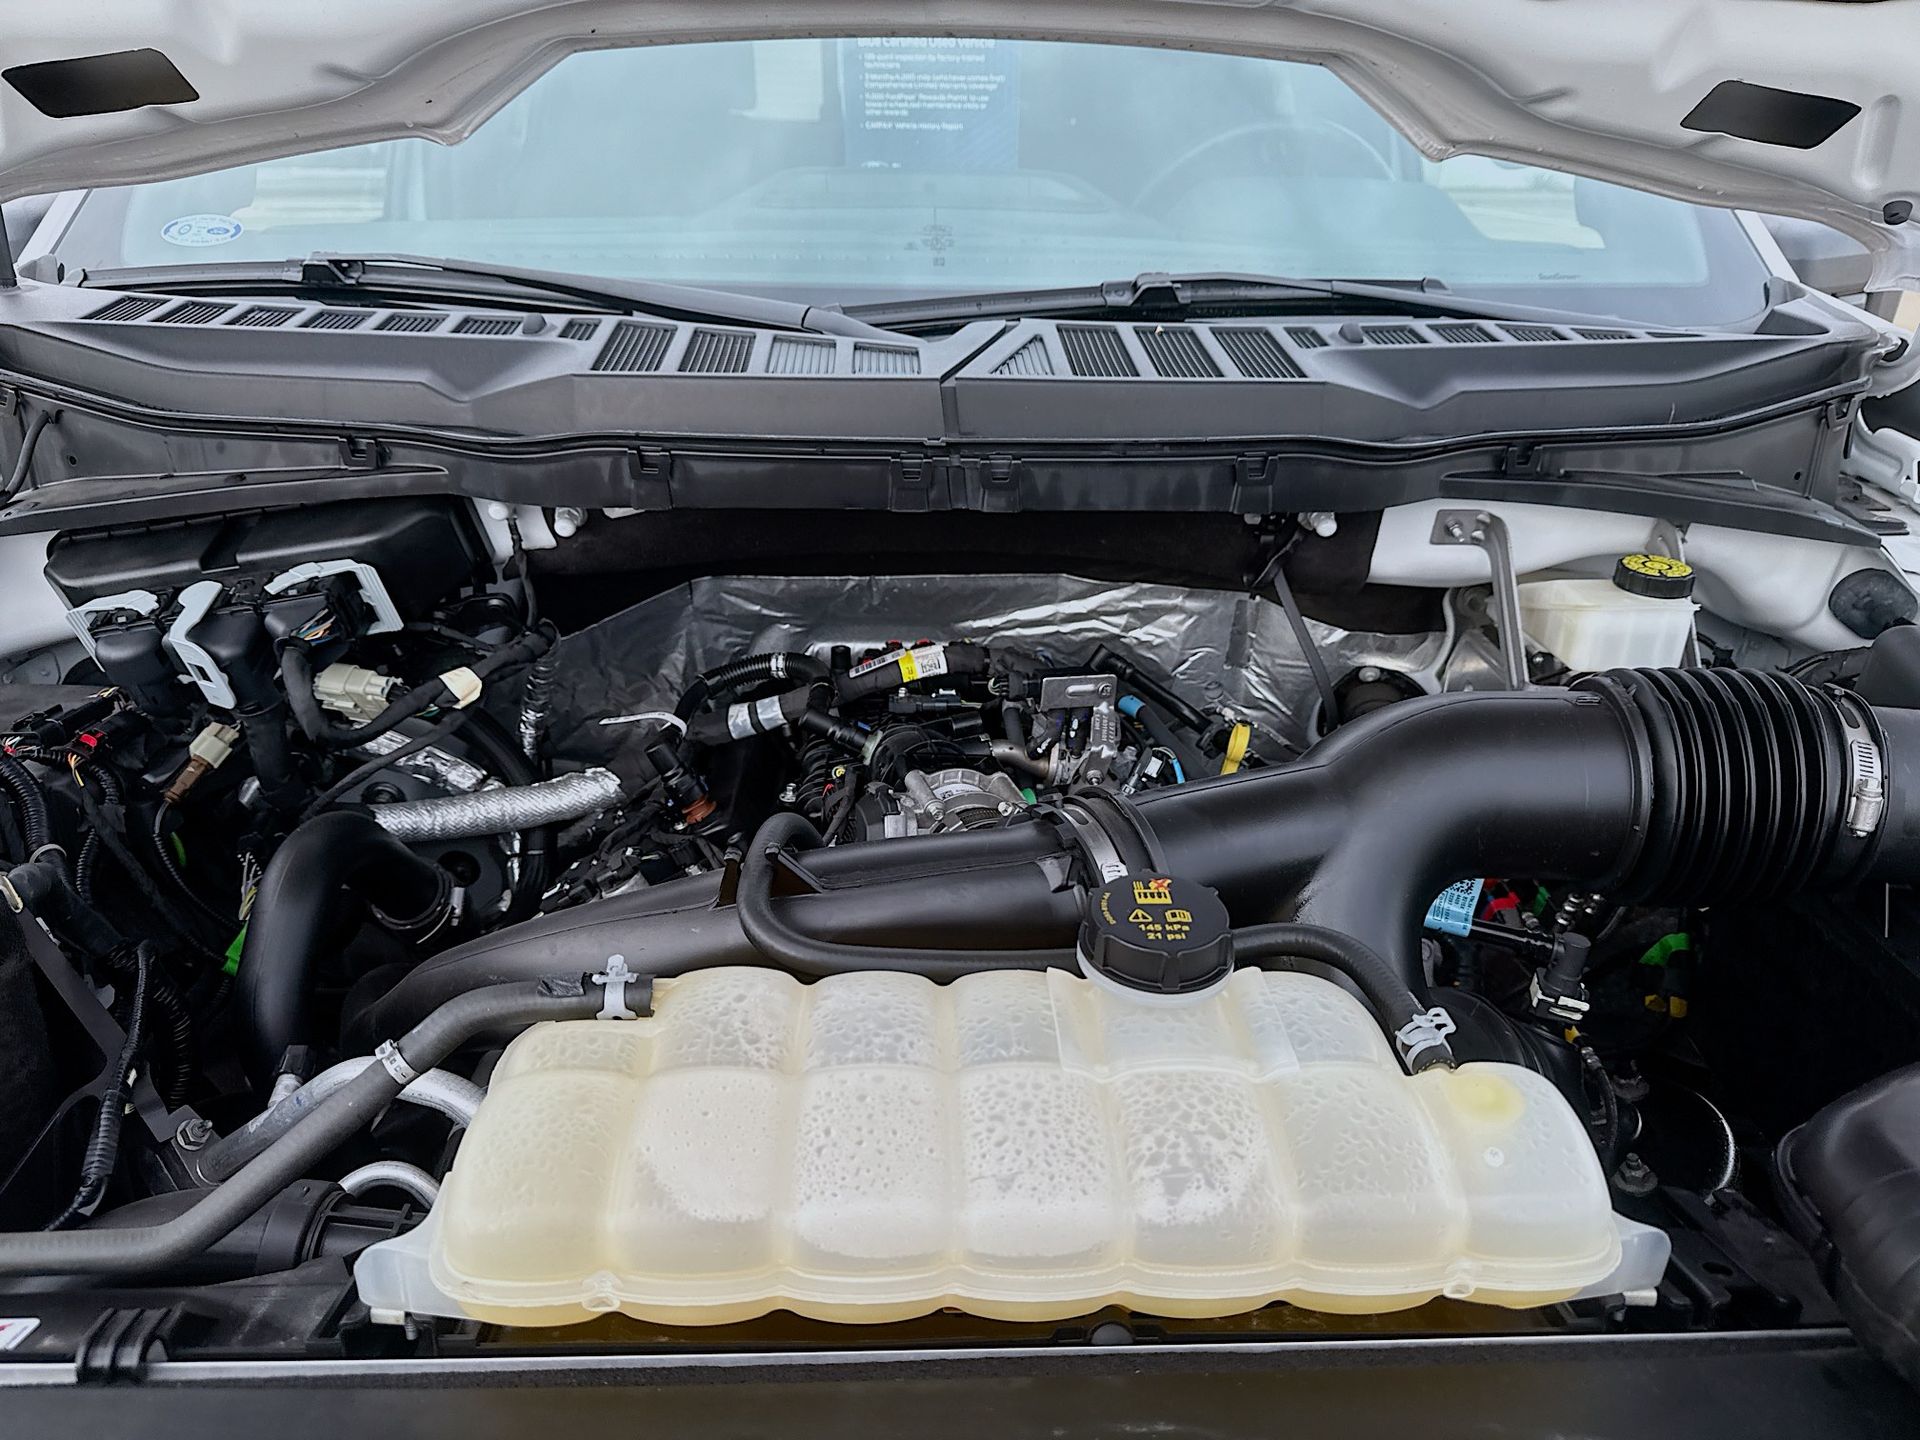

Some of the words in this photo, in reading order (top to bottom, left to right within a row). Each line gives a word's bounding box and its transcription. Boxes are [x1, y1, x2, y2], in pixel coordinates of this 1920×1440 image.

[1138, 923, 1163, 932] 145
[1164, 923, 1190, 932] kPa
[1147, 932, 1163, 940] 21
[1167, 932, 1187, 941] psi
